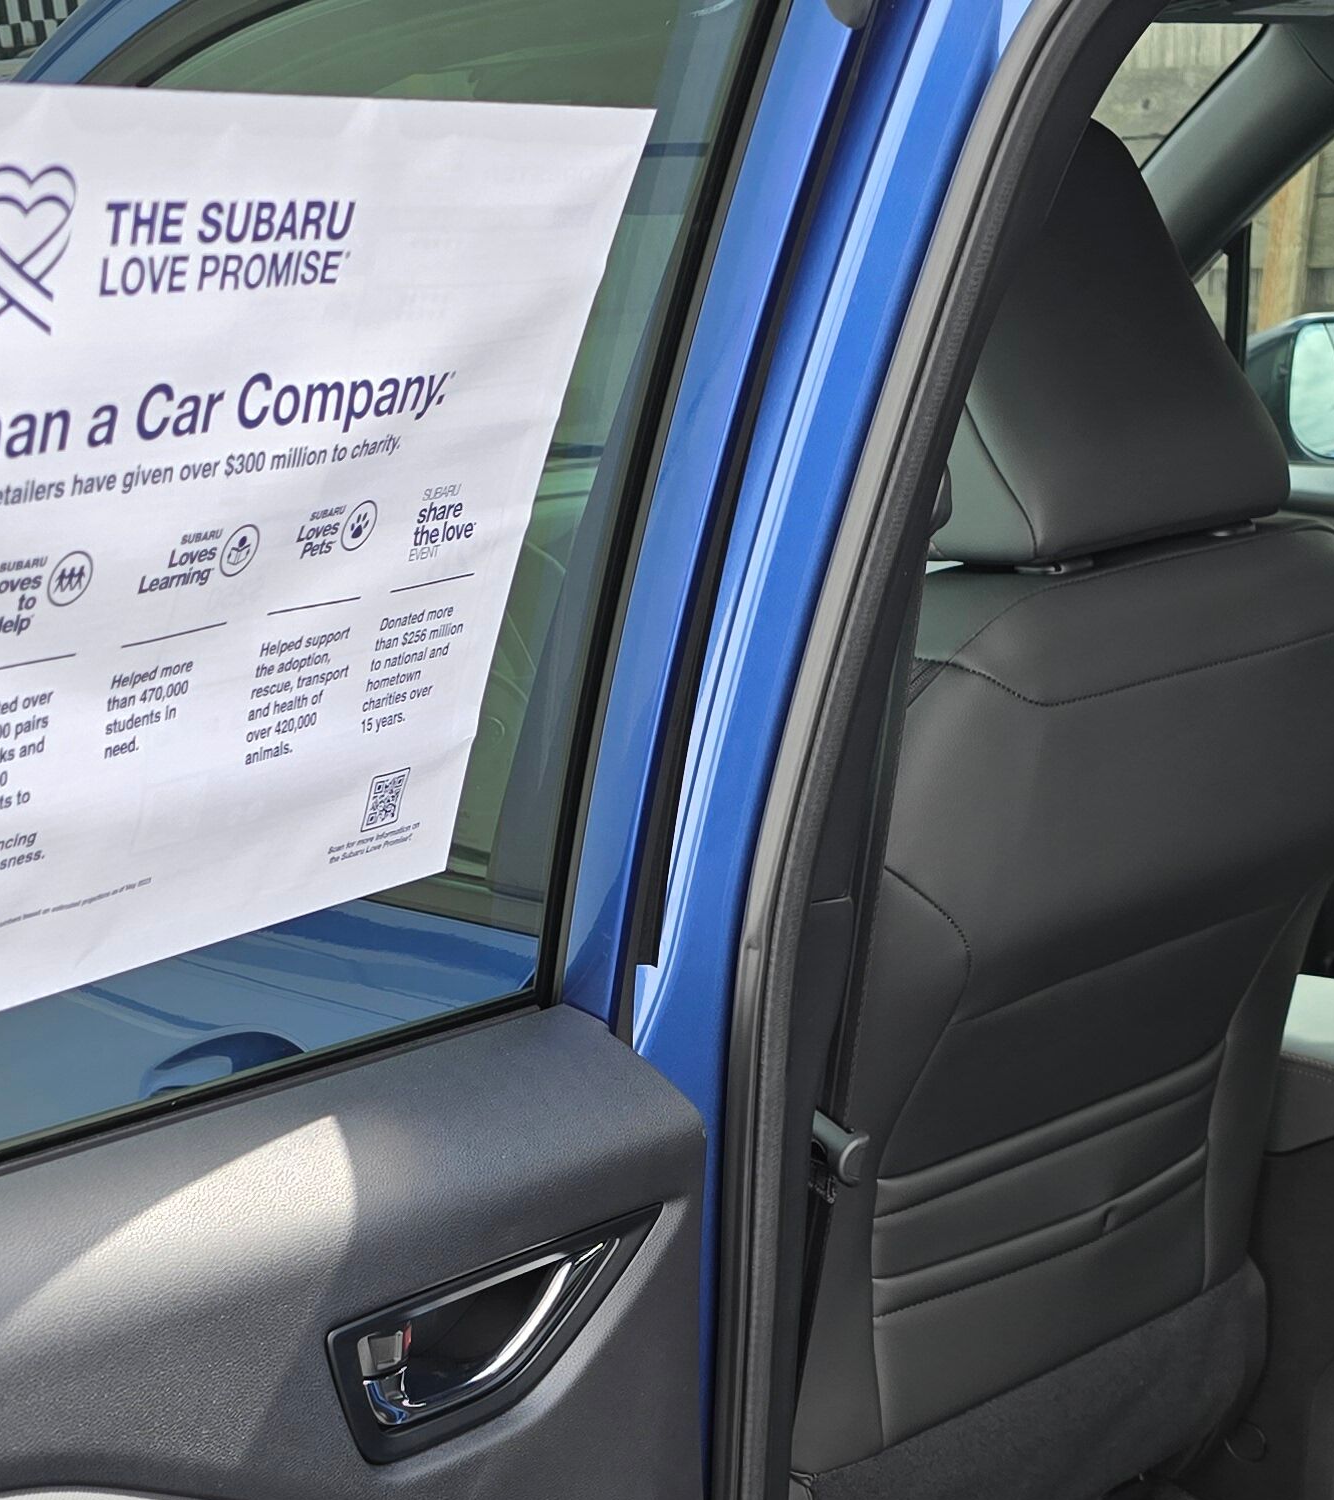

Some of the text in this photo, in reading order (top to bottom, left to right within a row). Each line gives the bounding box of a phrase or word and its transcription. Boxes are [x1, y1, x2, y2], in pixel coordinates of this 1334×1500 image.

[105, 200, 356, 247] THE SUBARU
[99, 249, 343, 297] LOVE PROMISE
[87, 404, 118, 448] a
[136, 383, 225, 441] Car
[237, 372, 448, 433] Company.
[71, 474, 117, 496] have
[121, 464, 173, 494] given
[180, 460, 220, 481] over
[224, 451, 266, 478] $300
[270, 446, 327, 470] million
[331, 444, 347, 463] to
[351, 434, 401, 459] charity.
[422, 484, 461, 501] SUBARU
[309, 505, 347, 521] SUBARU
[417, 502, 463, 524] share
[180, 528, 224, 545] SUBARU
[296, 521, 340, 544] Loves
[413, 521, 474, 547] the love
[168, 546, 218, 570] Loves
[300, 542, 333, 560] Pets
[408, 545, 441, 562] EVENT
[0, 556, 48, 573] SUBARU
[138, 568, 211, 595] Learning
[18, 593, 37, 611] to
[379, 606, 454, 632] Donated more
[259, 626, 351, 657] Helped support
[375, 622, 463, 652] than $256 million
[255, 652, 331, 678] the adoption,
[370, 642, 450, 672] to national and
[110, 661, 193, 690] Helped more
[251, 664, 349, 699] rescue, transport
[366, 670, 421, 692] hometown
[22, 691, 54, 710] over
[107, 680, 189, 712] than 470,000
[248, 689, 324, 721] and health of
[362, 685, 433, 712] charities over
[14, 715, 49, 740] pairs
[105, 705, 176, 735] students in
[246, 712, 317, 743] over 420,000
[361, 712, 405, 733] 15 years.
[19, 736, 45, 758] and
[104, 736, 139, 759] need.
[245, 741, 293, 765] animals.
[16, 790, 30, 805] to
